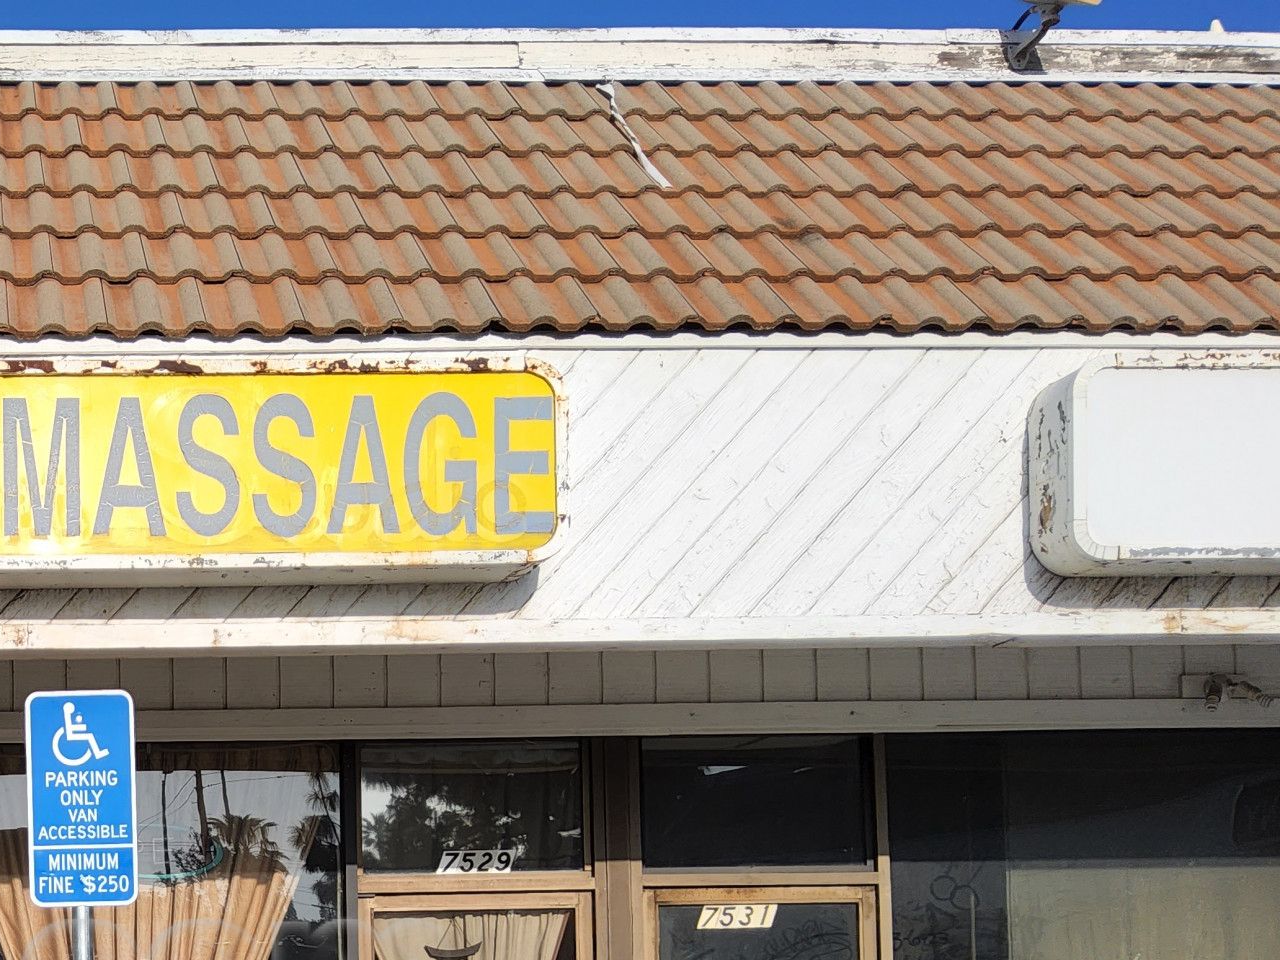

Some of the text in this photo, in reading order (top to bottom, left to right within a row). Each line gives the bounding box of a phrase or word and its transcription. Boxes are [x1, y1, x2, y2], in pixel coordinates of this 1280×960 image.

[2, 393, 554, 537] MASSAGE
[45, 769, 118, 788] PARKING
[60, 789, 103, 806] ONLY
[68, 808, 97, 822] VAN
[38, 824, 128, 840] ACCESSIBLE
[48, 853, 119, 871] MINIMUM
[442, 851, 511, 872] 7529
[39, 874, 130, 894] FINE $250
[702, 906, 770, 927] 7531
